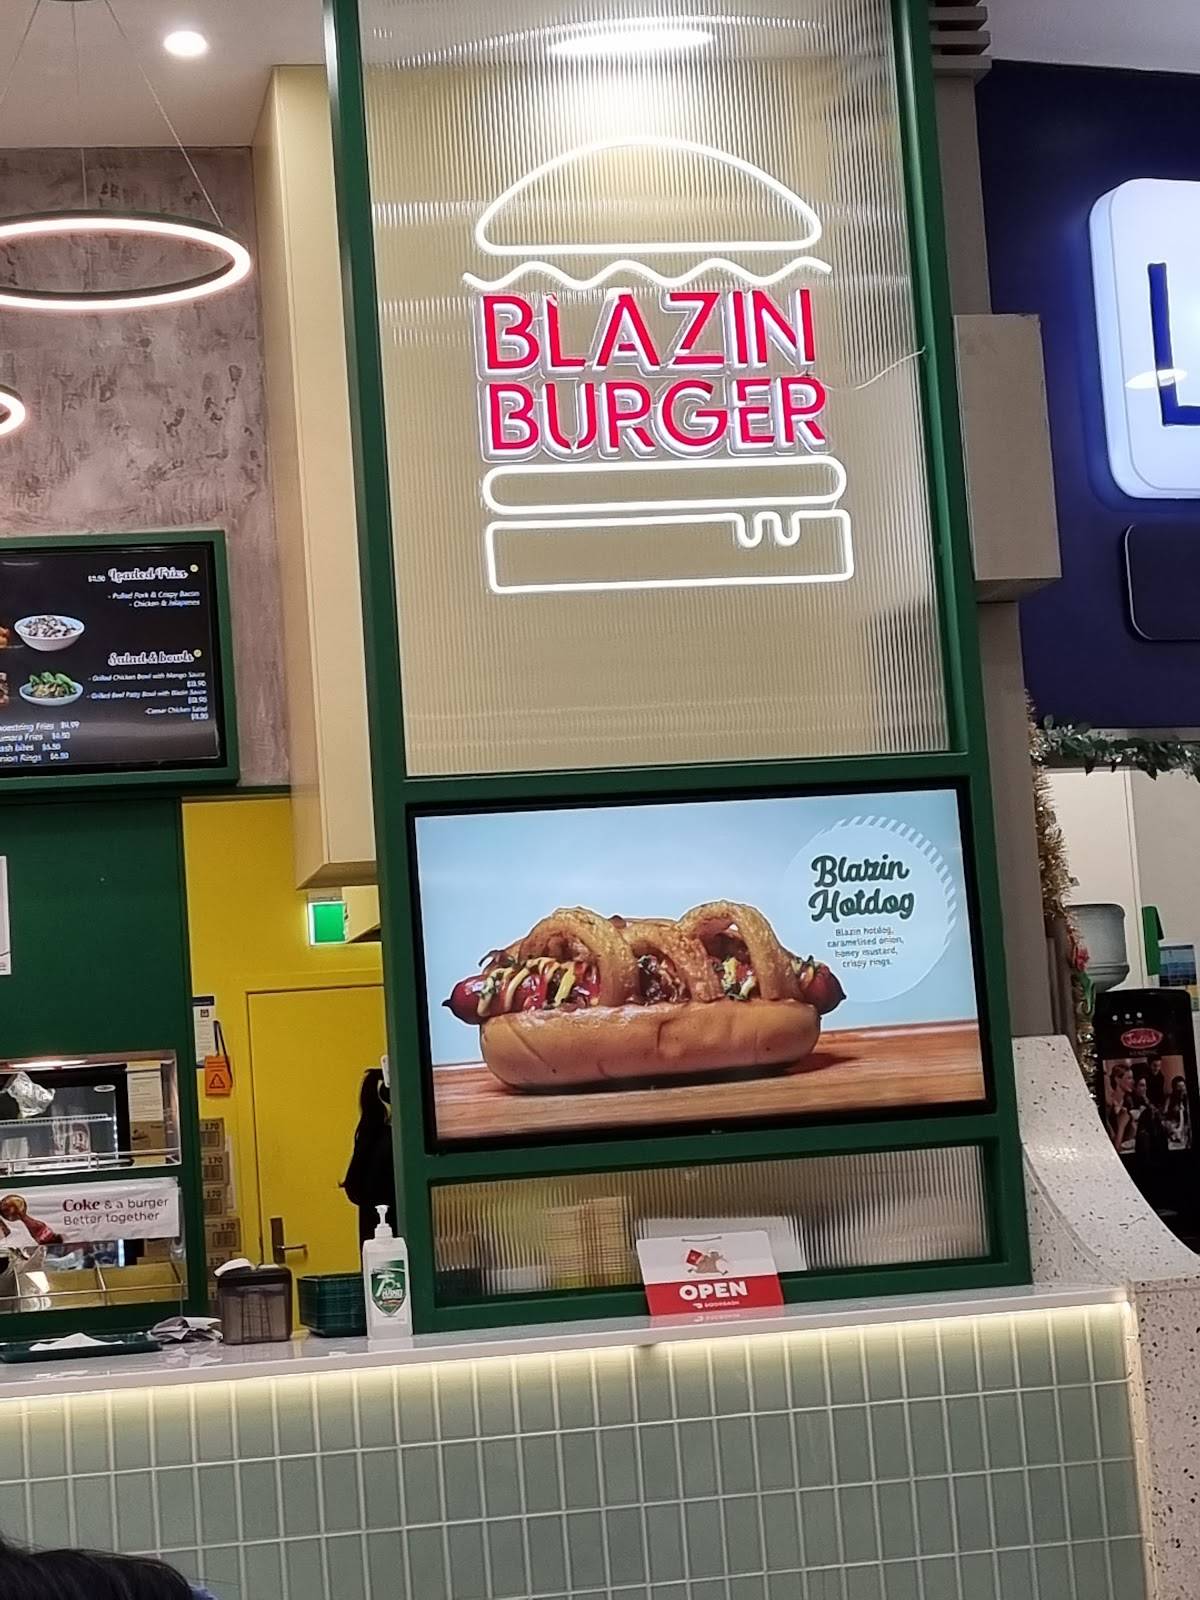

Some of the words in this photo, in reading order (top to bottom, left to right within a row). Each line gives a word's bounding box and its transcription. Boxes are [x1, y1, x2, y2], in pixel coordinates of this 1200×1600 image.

[482, 287, 816, 370] BLAZIN
[487, 374, 827, 451] BURGER
[108, 651, 147, 667] Salad
[811, 853, 910, 888] Blazin
[808, 887, 915, 923] Hotdog
[835, 928, 861, 936] Blazin
[834, 950, 860, 959] honey
[842, 960, 867, 969] crispy
[62, 1198, 101, 1213] Coke
[116, 1201, 124, 1209] a
[127, 1198, 169, 1210] burger
[63, 1214, 102, 1226] Better
[105, 1211, 160, 1225] together
[679, 1280, 748, 1301] OPEN
